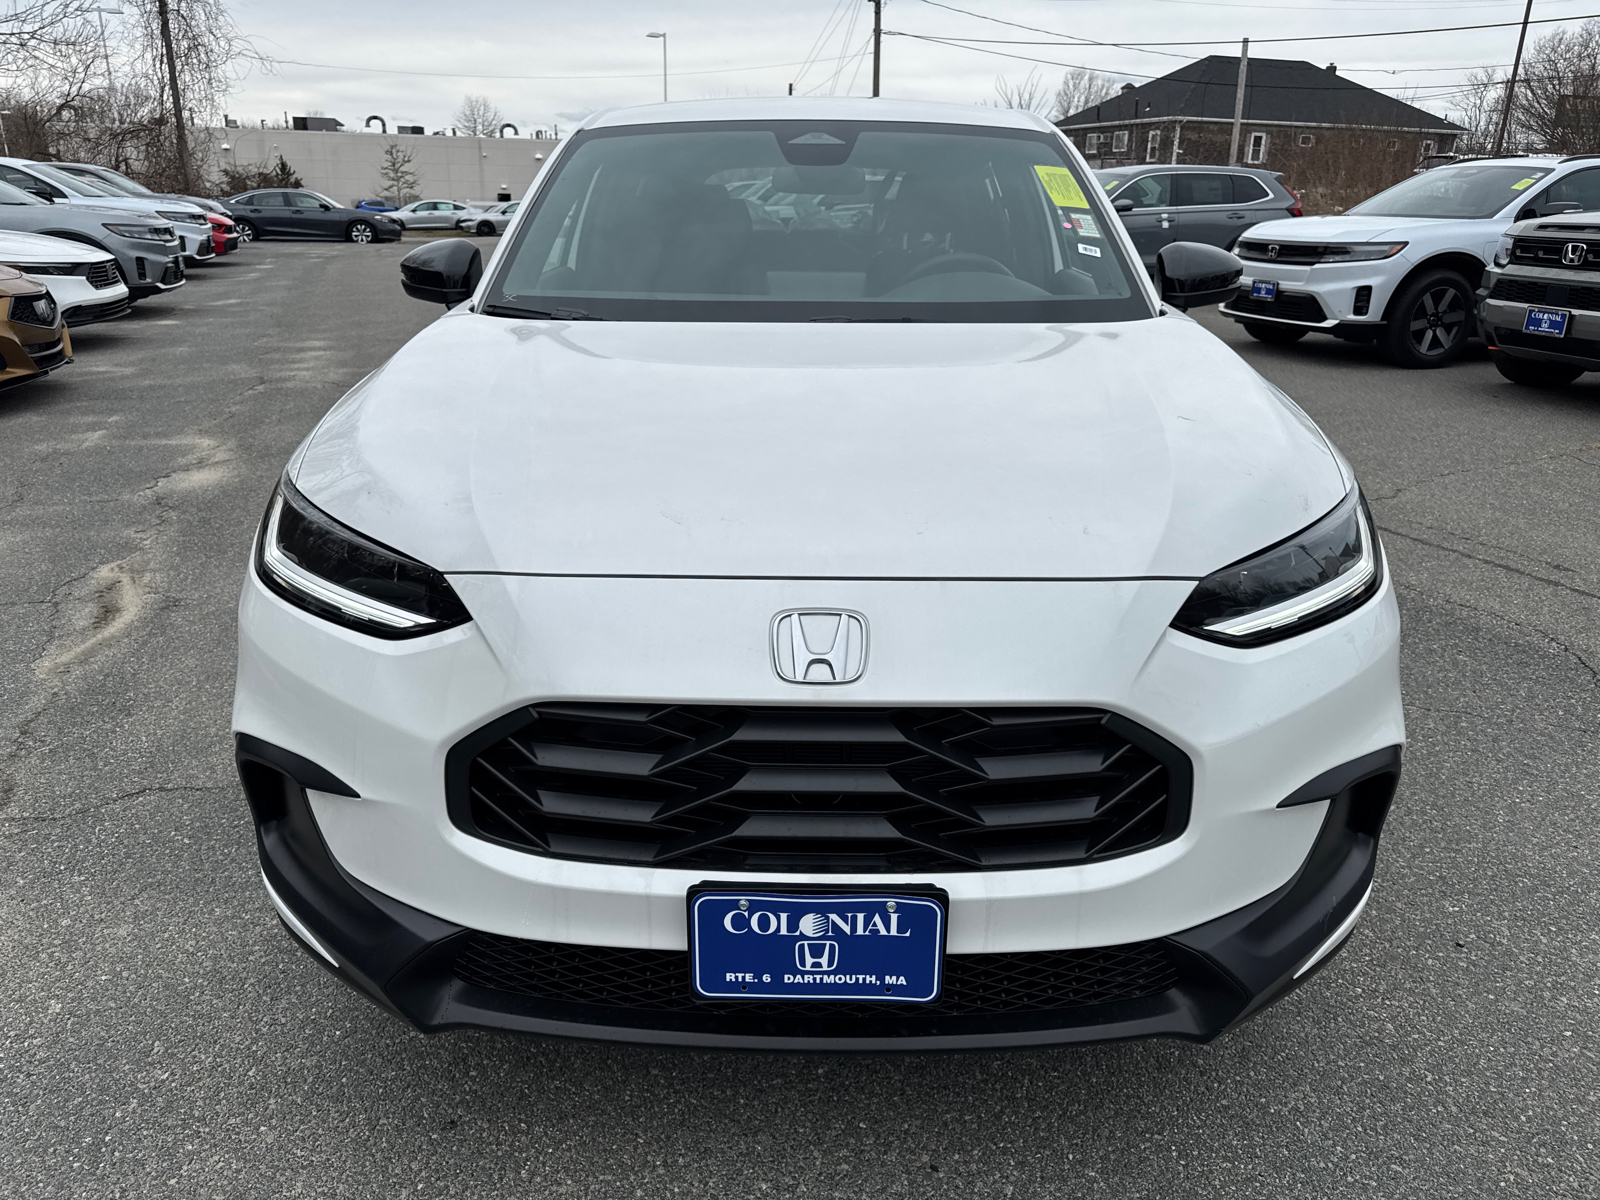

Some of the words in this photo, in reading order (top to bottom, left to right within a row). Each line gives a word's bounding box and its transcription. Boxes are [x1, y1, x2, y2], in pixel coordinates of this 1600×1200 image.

[723, 910, 911, 937] COLONIAL
[725, 973, 758, 983] RTE.
[762, 973, 771, 983] 6
[784, 974, 880, 985] DARTMOUTH,
[884, 975, 907, 985] MA
